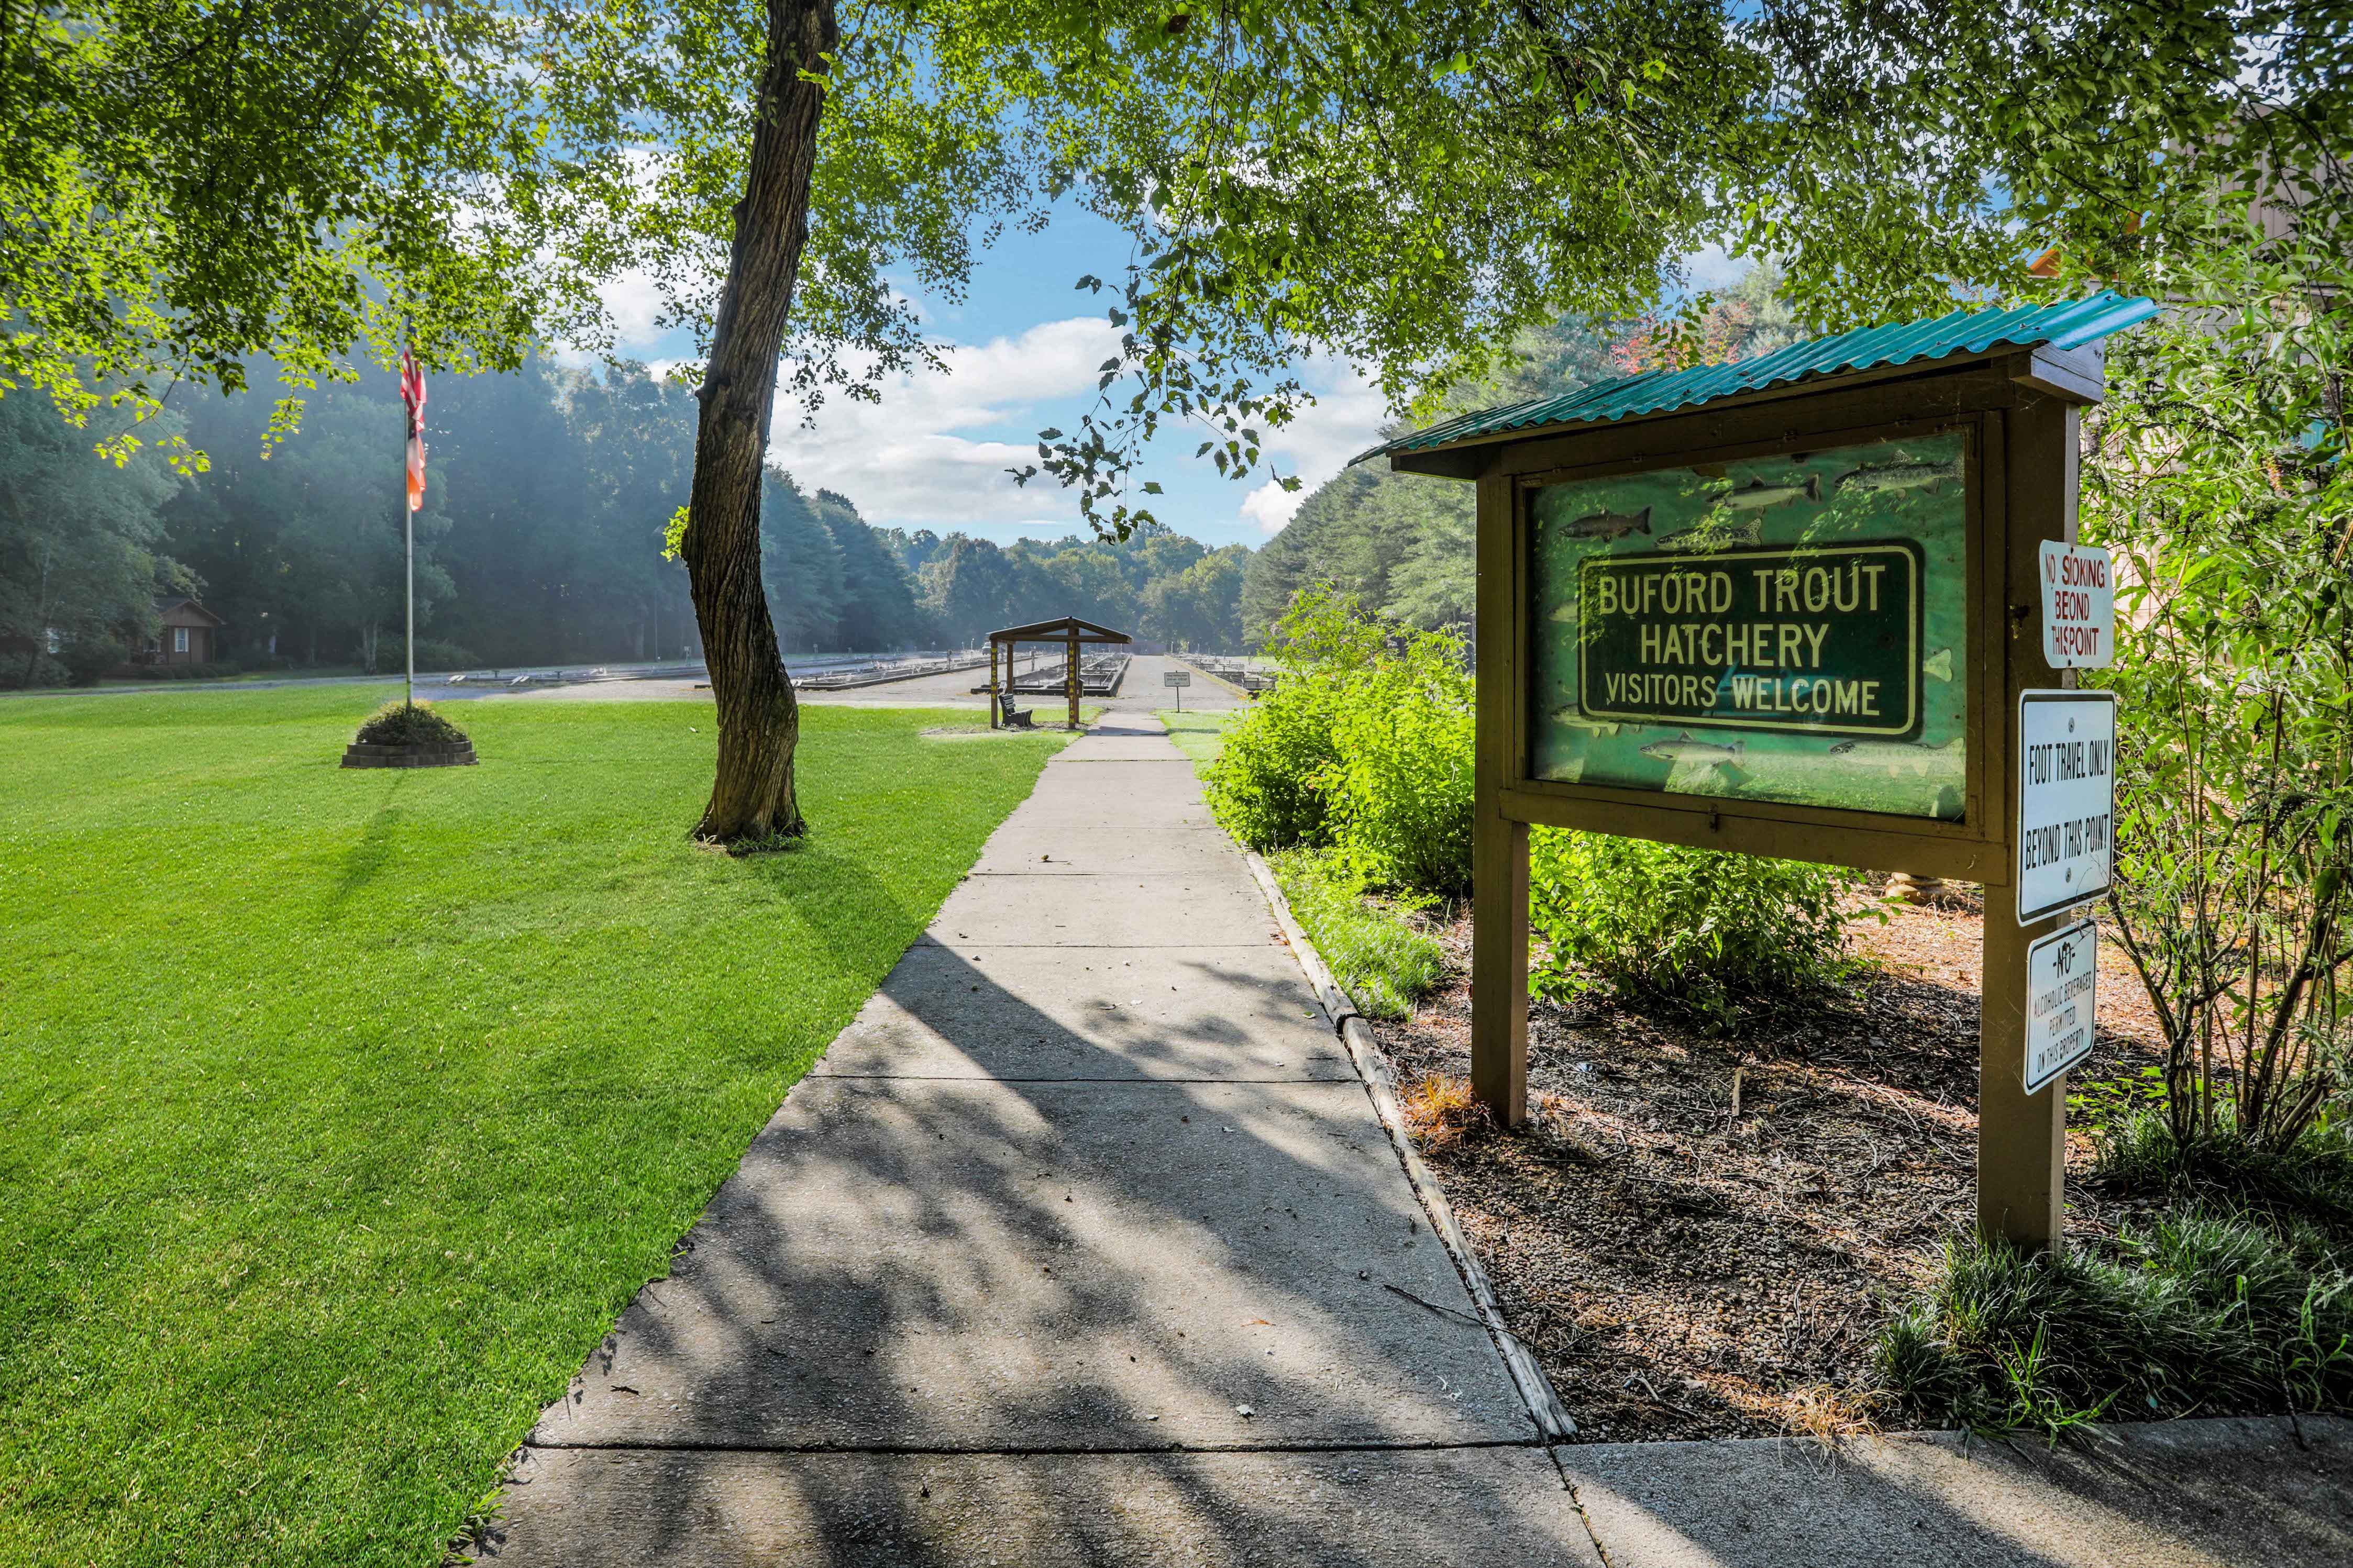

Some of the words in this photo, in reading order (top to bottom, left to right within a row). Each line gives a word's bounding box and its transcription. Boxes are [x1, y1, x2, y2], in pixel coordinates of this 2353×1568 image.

[1600, 571, 1732, 616] BUFORD
[1753, 565, 1885, 612] TROUT
[2046, 553, 2056, 584] NO
[2062, 555, 2105, 588] SOKING
[2055, 591, 2090, 621] BEOND
[1640, 623, 1829, 668] HATCHERY
[2051, 626, 2068, 655] THIS
[2069, 627, 2099, 656] POINT
[1604, 672, 1717, 708] VISITORS
[1732, 677, 1880, 716] WELCOME
[2029, 744, 2052, 785] FOOT
[2056, 741, 2085, 782] TRAVEL
[2089, 740, 2108, 777] ONLY
[2026, 824, 2060, 870] BEYOND
[2064, 819, 2082, 859] THIS
[2085, 814, 2108, 854] POINT
[2034, 986, 2063, 1019] ALCOHOLIC
[2064, 971, 2092, 1002] BEVERAGES
[2049, 1006, 2076, 1039] PERMITTED
[2037, 1051, 2045, 1073] ON
[2047, 1043, 2058, 1068] THIS
[2060, 1026, 2084, 1059] PROPERTY
